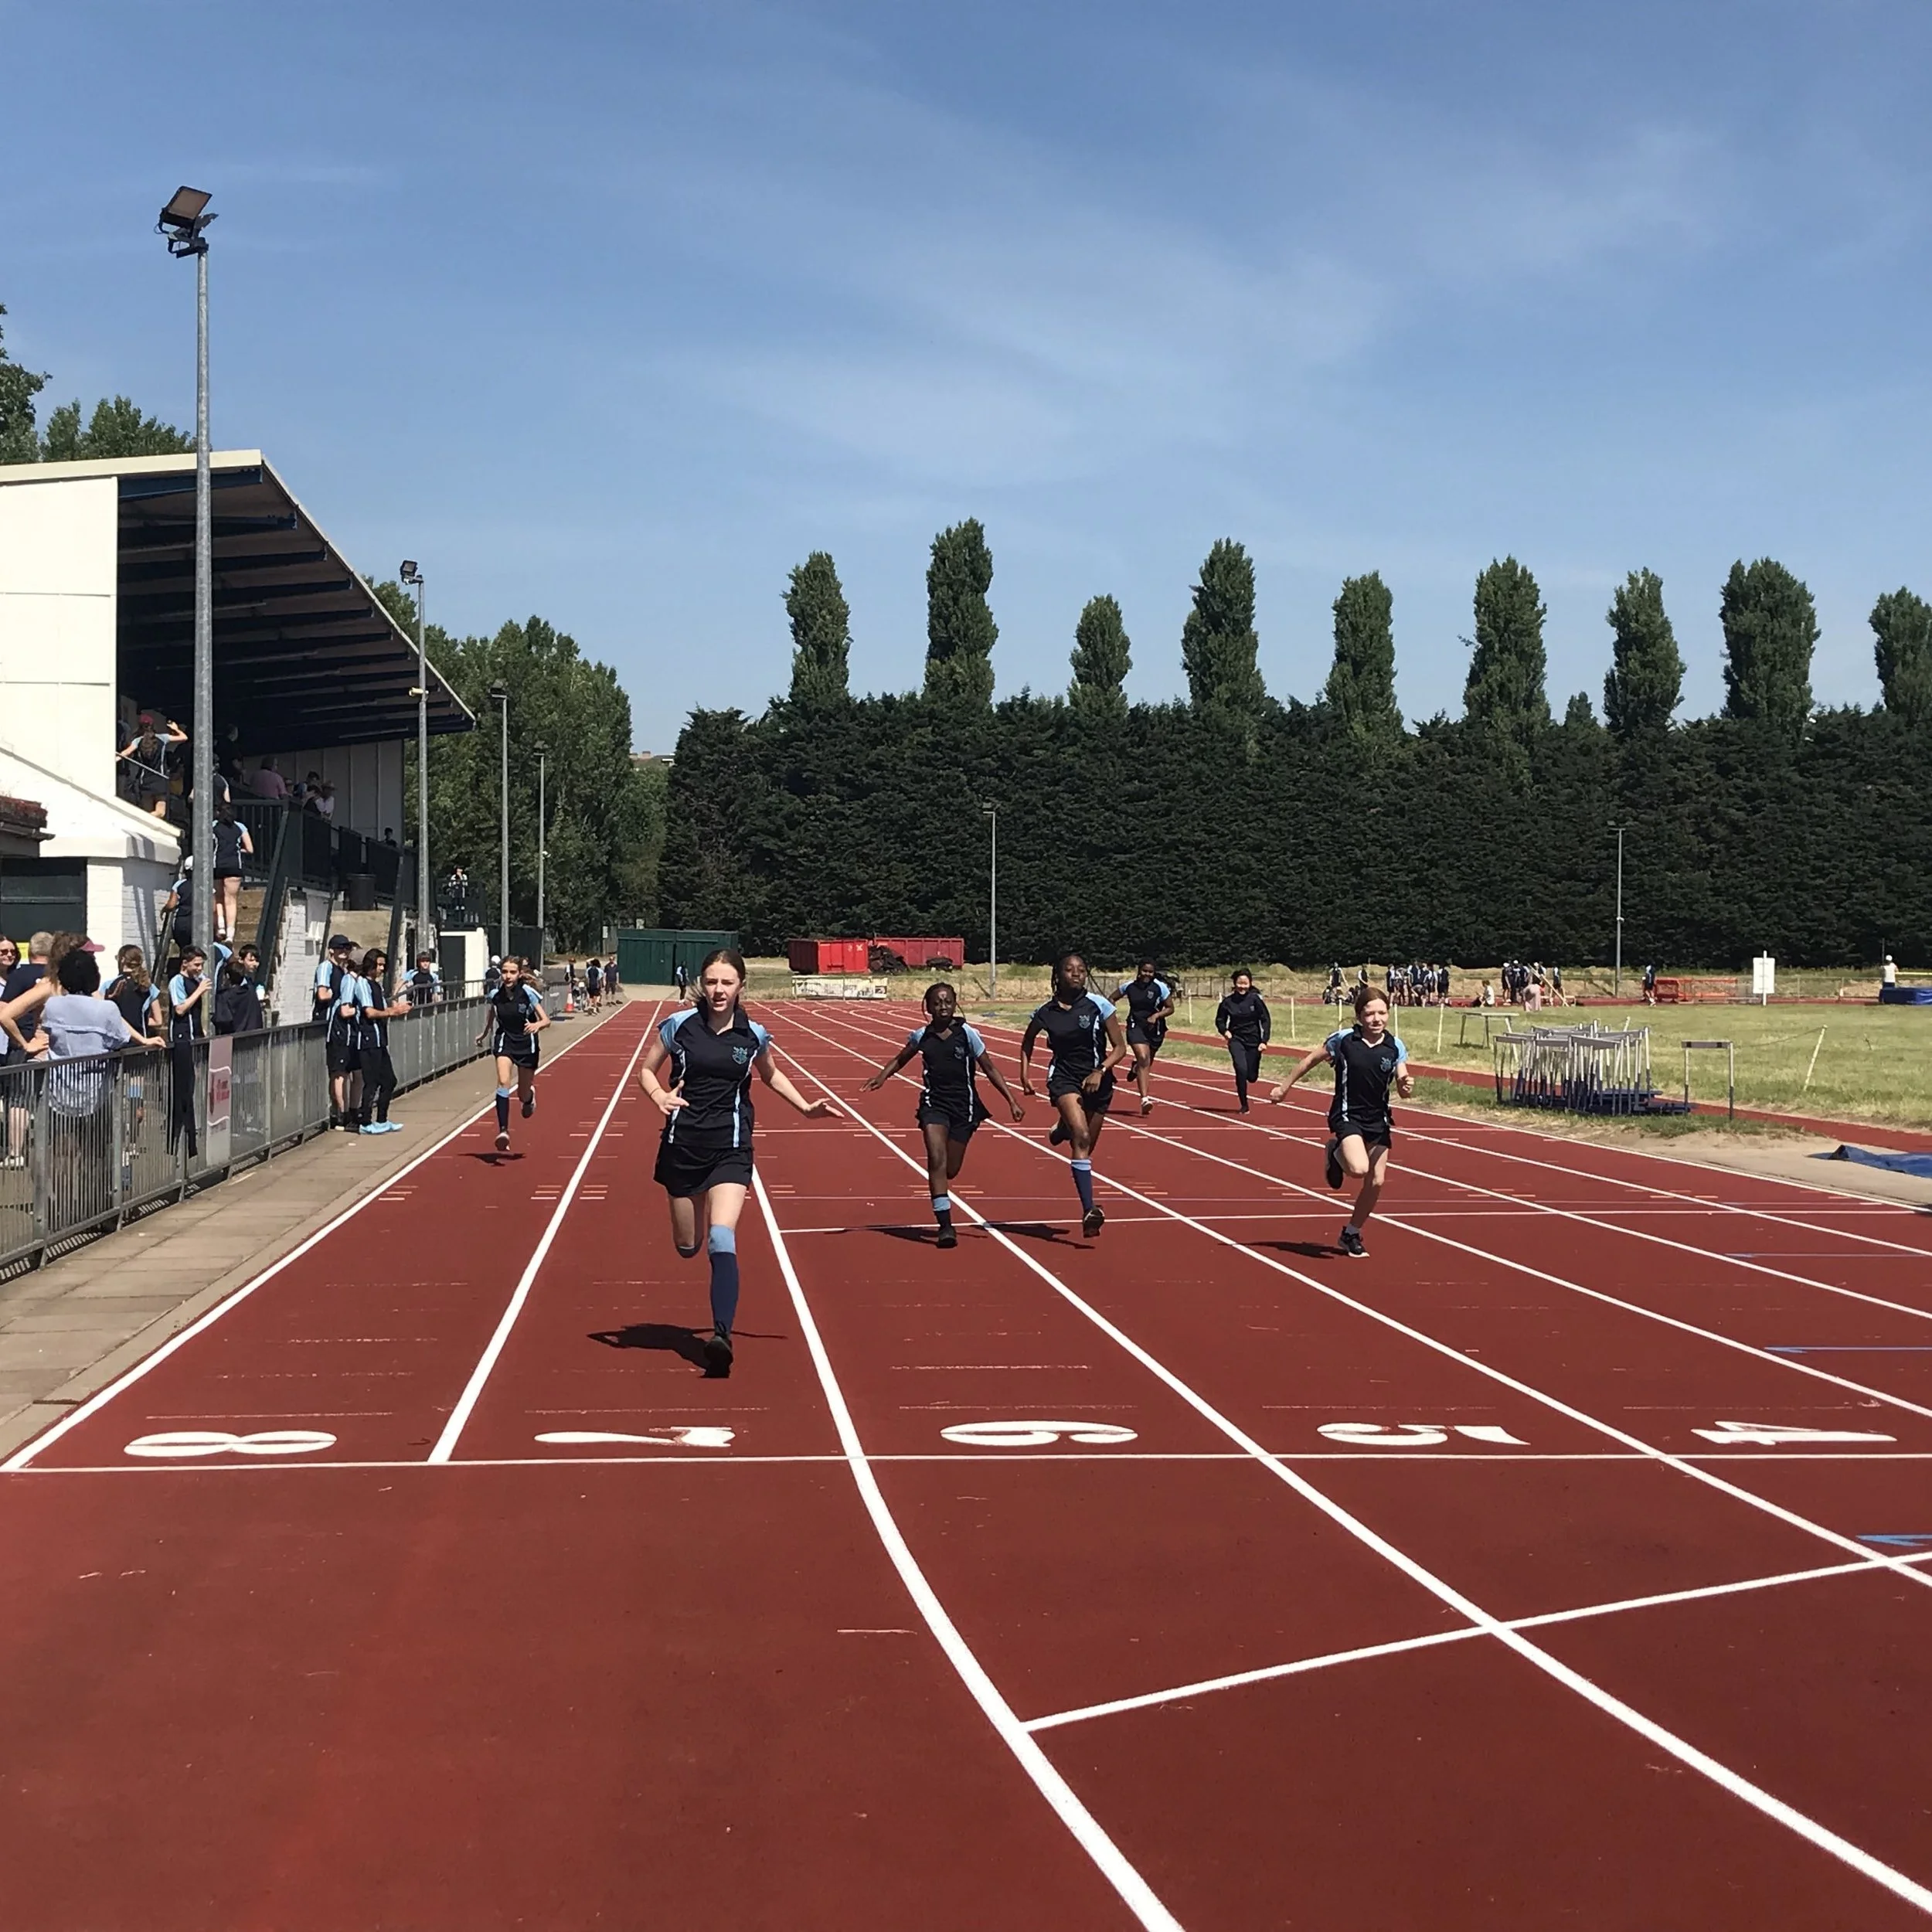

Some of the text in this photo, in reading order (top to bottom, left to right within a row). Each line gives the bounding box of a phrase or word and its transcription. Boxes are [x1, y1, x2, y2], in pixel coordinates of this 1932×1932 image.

[124, 1430, 337, 1458] 8
[534, 1426, 736, 1447] 7
[940, 1420, 1138, 1447] 6
[1317, 1422, 1531, 1446] 5
[1691, 1420, 1898, 1446] 4
